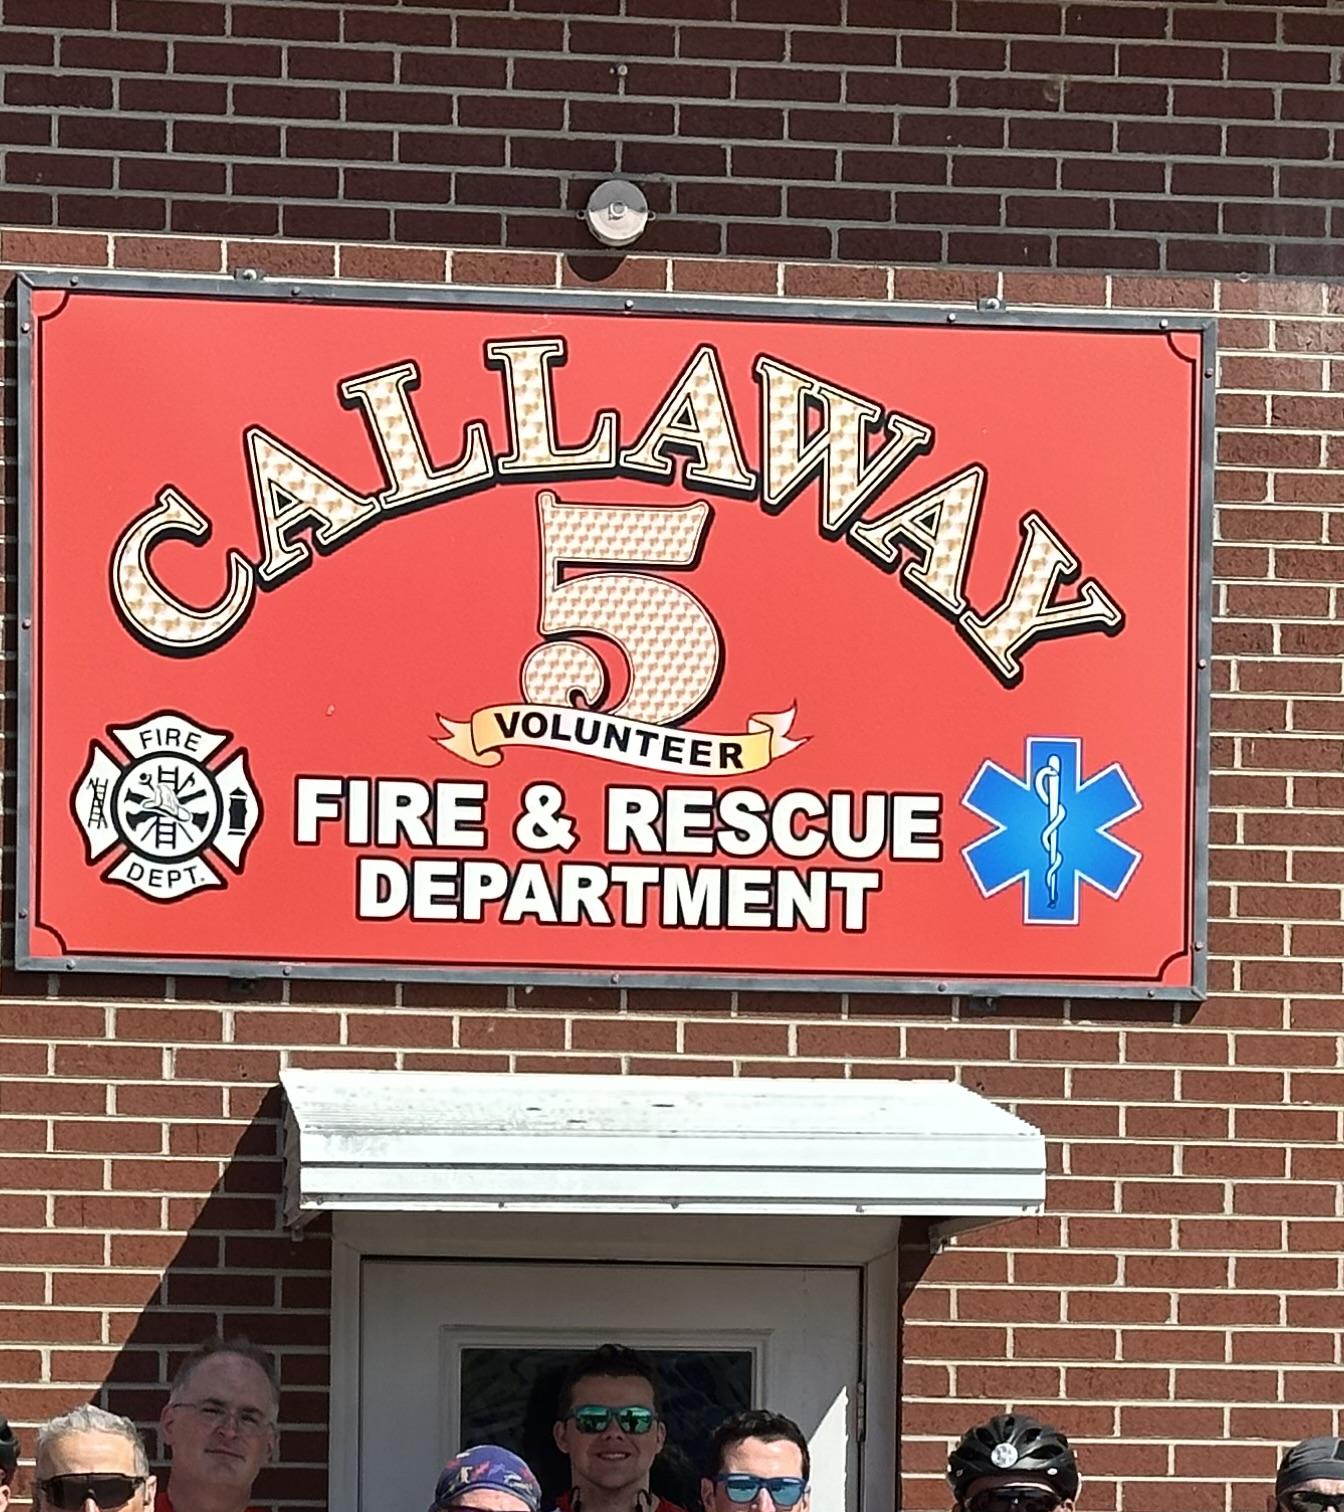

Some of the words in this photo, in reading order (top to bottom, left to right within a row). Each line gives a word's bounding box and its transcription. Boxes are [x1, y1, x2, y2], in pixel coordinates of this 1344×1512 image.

[112, 334, 1127, 686] CALLAWAY
[520, 490, 721, 727] 5
[139, 727, 202, 752] FIRE
[494, 710, 746, 771] VOLUNTEER
[294, 776, 487, 850] FIRE
[515, 780, 579, 855] &
[604, 785, 945, 863] RESCUE
[126, 862, 206, 888] DEPT.
[357, 861, 882, 933] DEPARTMENT
